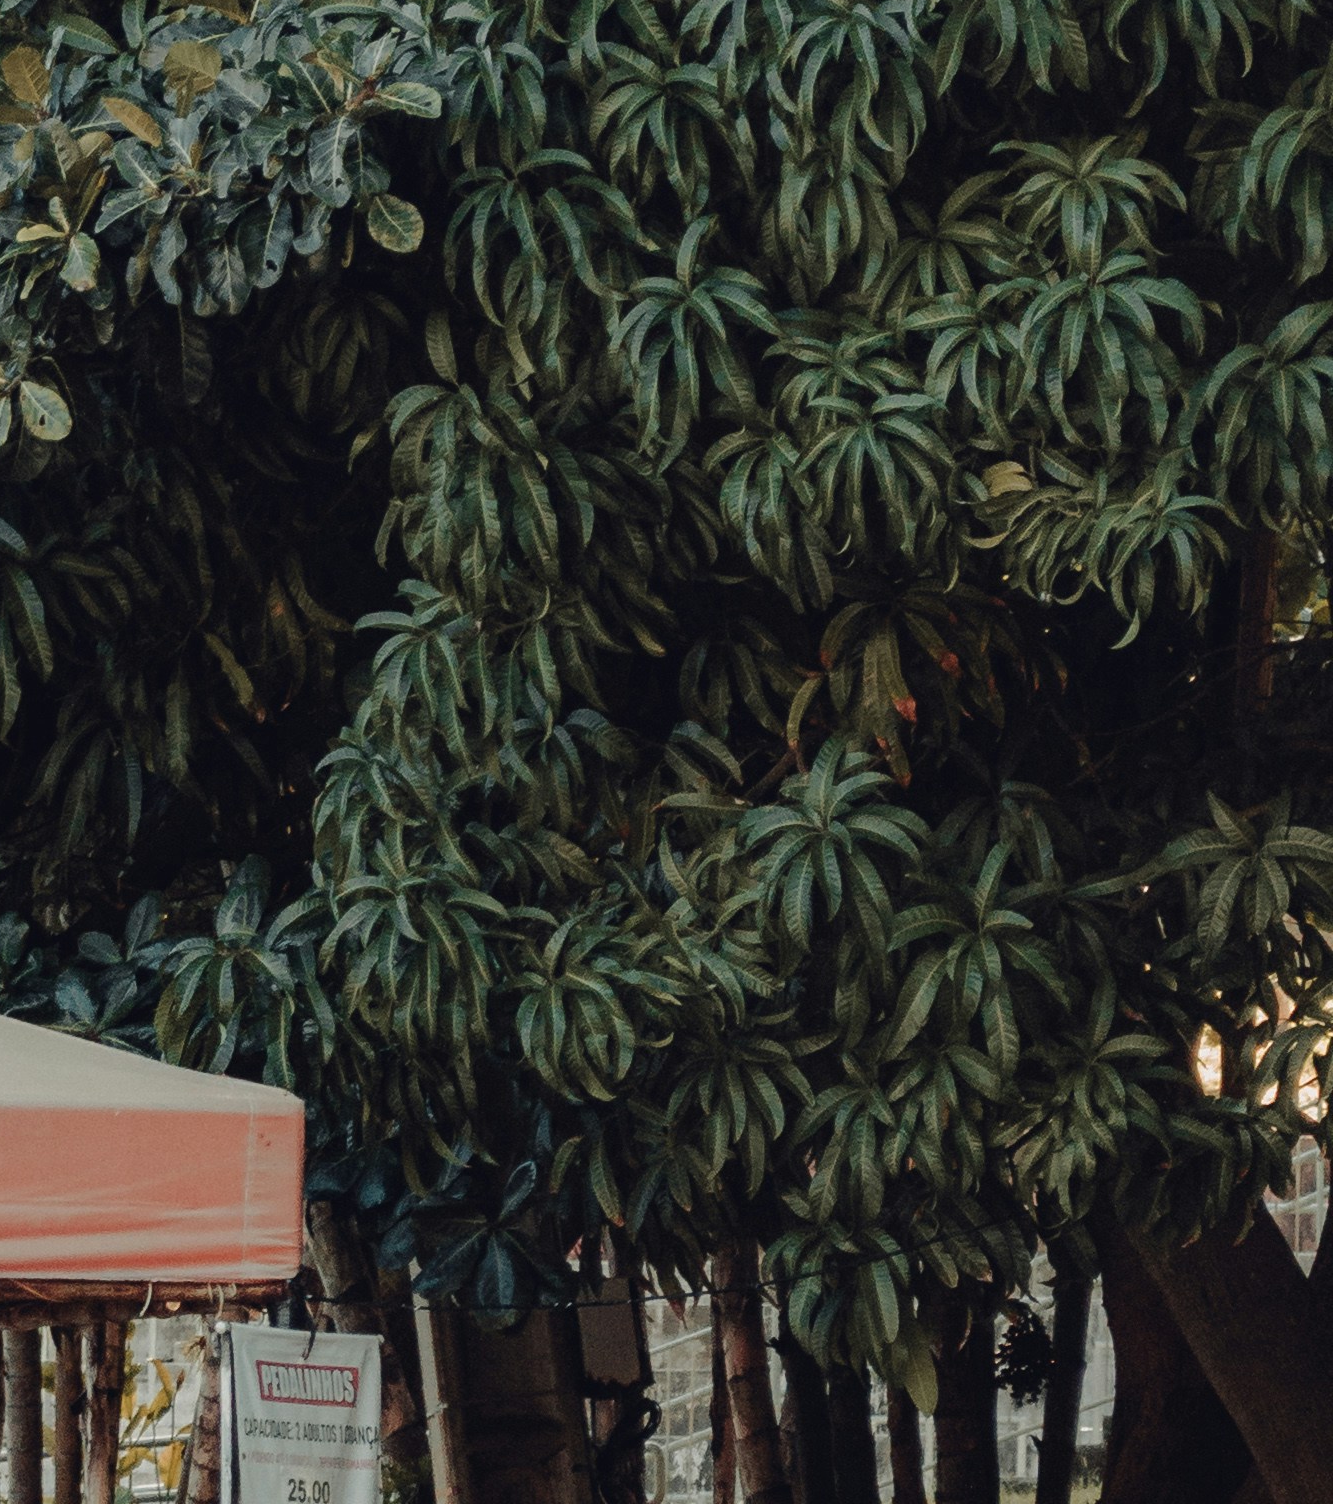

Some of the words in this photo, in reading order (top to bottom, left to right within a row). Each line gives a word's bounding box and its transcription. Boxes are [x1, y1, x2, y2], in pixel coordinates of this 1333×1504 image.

[261, 1364, 355, 1404] PEDALINHOS
[295, 1421, 301, 1441] 2
[303, 1422, 337, 1443] ADULTOS
